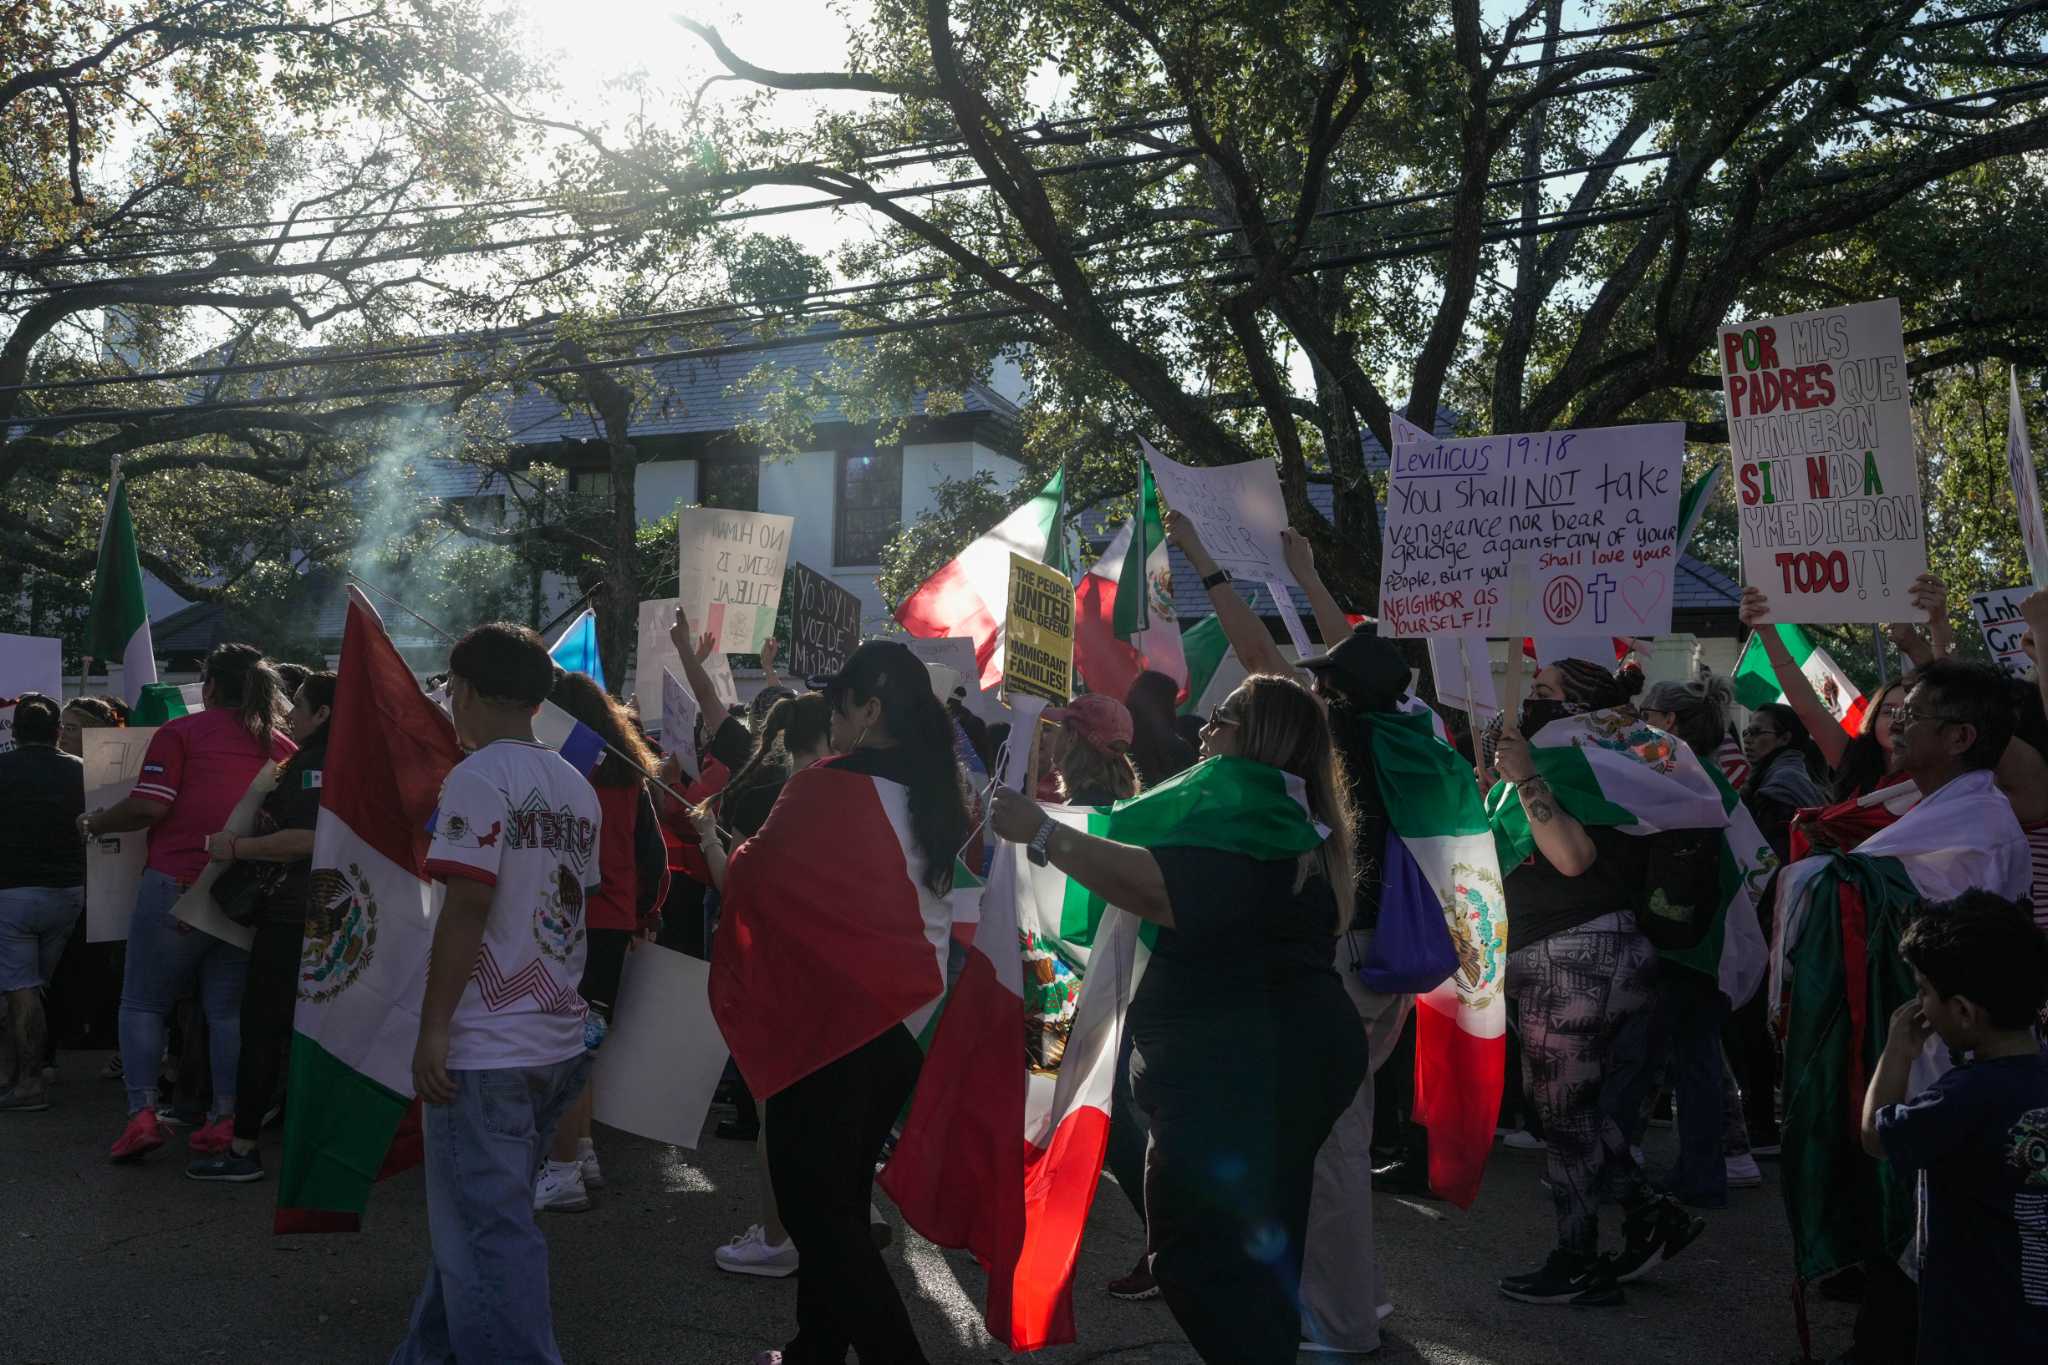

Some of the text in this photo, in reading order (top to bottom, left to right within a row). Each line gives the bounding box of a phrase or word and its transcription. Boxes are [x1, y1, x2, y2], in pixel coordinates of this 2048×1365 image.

[1724, 315, 1850, 374] POR MIS
[1729, 355, 1900, 418] PADRES QUE
[1506, 434, 1577, 468] 19:18
[1734, 404, 1880, 460] VINIERON
[1393, 460, 1669, 515] You Shall NOT take
[1740, 451, 1884, 506] SIN NADA
[1389, 516, 1502, 545] vengeance
[1626, 508, 1645, 525] a
[1802, 495, 1919, 546] DIERON
[1482, 532, 1565, 566] against
[1567, 531, 1601, 550] any
[1015, 566, 1071, 604] THE PEOPLE
[1384, 569, 1437, 593] people,
[1481, 566, 1509, 586] you
[1538, 550, 1582, 570] Shall
[1592, 549, 1625, 566] love
[1775, 549, 1890, 600] TODO!!
[1013, 602, 1070, 639] WILL DEFEND
[1015, 581, 1071, 625] UNITED
[1384, 589, 1464, 621] NEIGHBOR
[1390, 606, 1492, 637] YOURSELF!!
[800, 614, 845, 654] VOZ DE
[1009, 655, 1067, 693] FAMILIES!
[1011, 639, 1067, 674] IMMIGRANT
[511, 809, 597, 854] MEXIC
